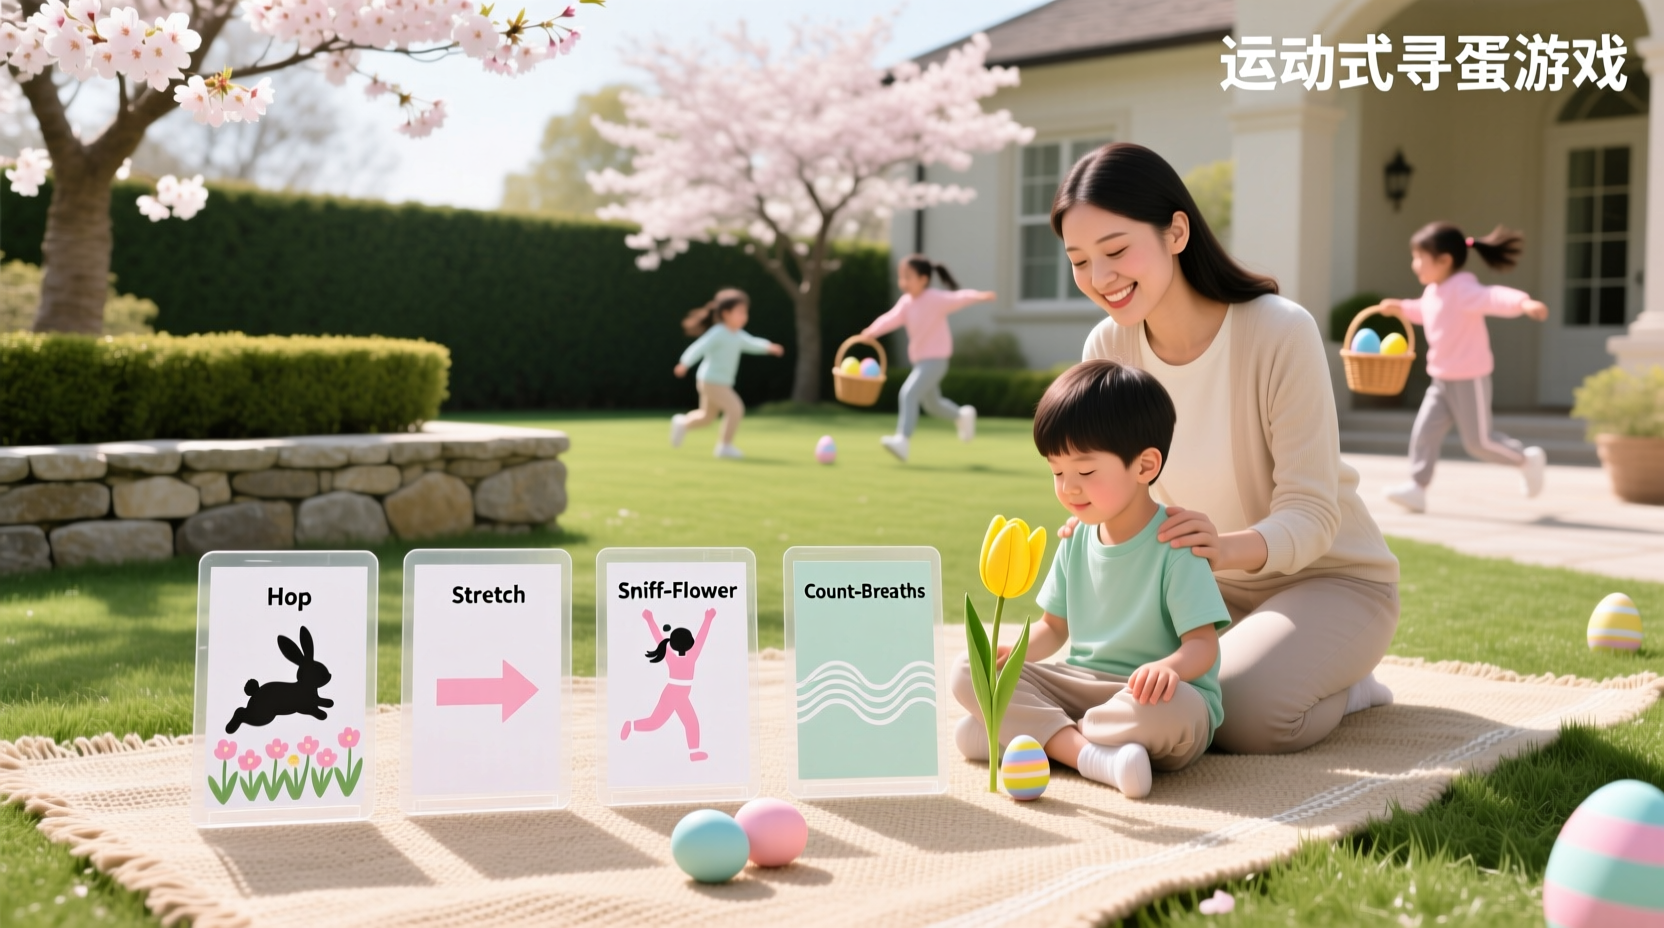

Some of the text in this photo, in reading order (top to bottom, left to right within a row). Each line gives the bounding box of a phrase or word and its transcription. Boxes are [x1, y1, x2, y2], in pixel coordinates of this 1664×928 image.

[267, 586, 312, 612] Hop
[452, 584, 526, 605] Stretch
[617, 579, 738, 601] Sniff-Flower
[804, 582, 926, 600] Count-Breaths
